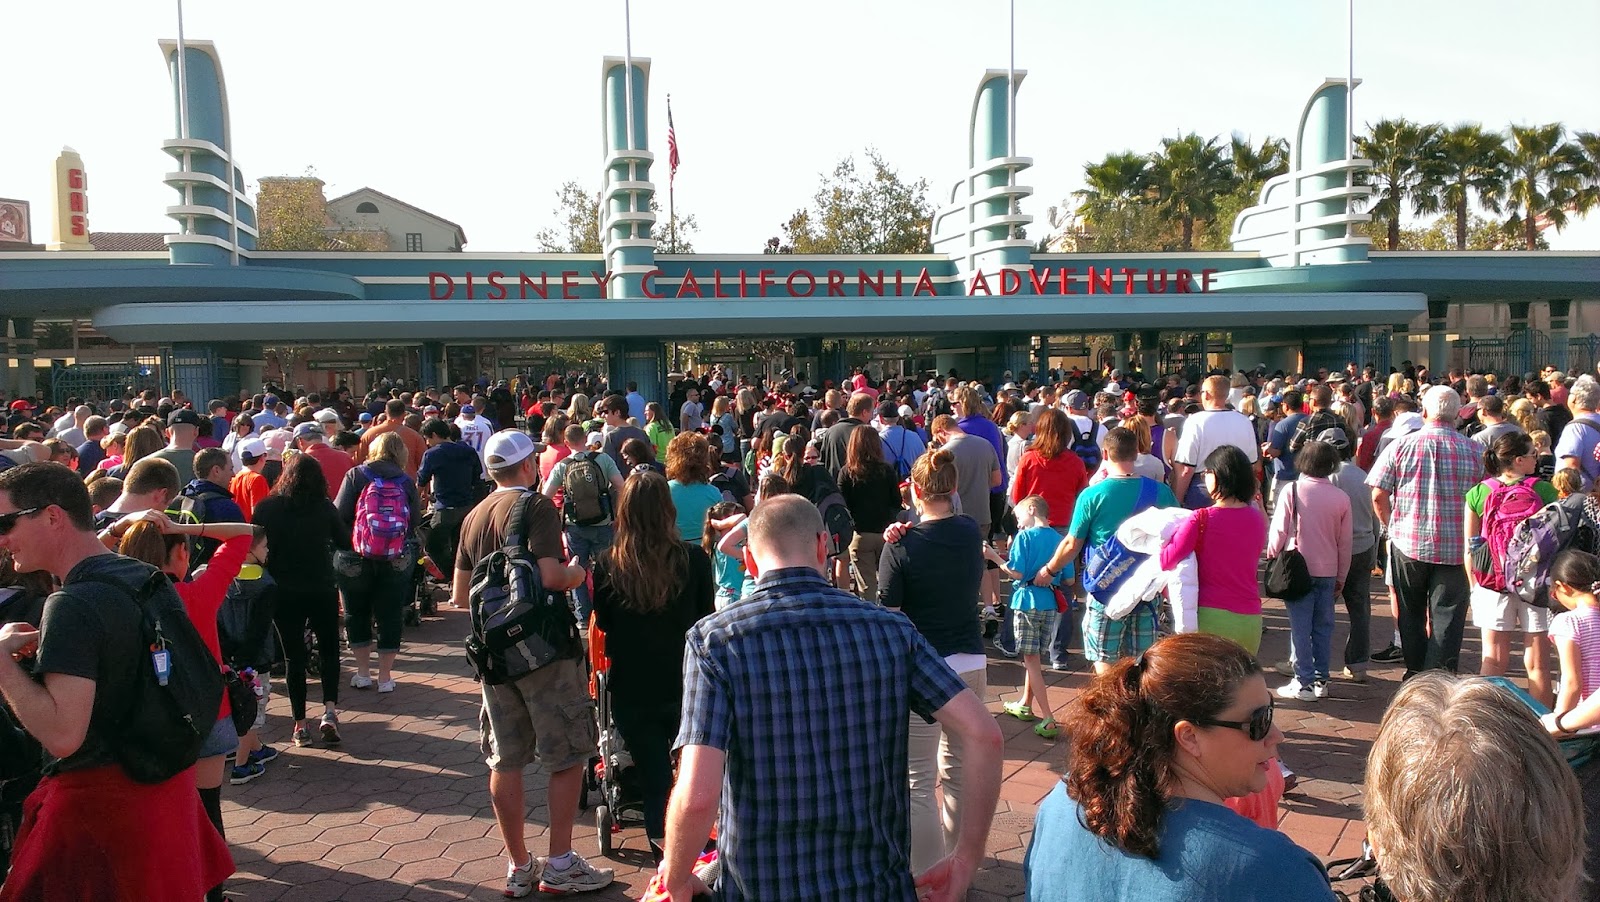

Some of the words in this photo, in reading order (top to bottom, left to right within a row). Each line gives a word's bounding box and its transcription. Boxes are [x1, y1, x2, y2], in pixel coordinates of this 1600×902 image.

[68, 169, 85, 236] GAS
[429, 270, 613, 300] DISNEY
[641, 268, 937, 298] CALIFORNIA
[969, 266, 1218, 296] ADVENTURE
